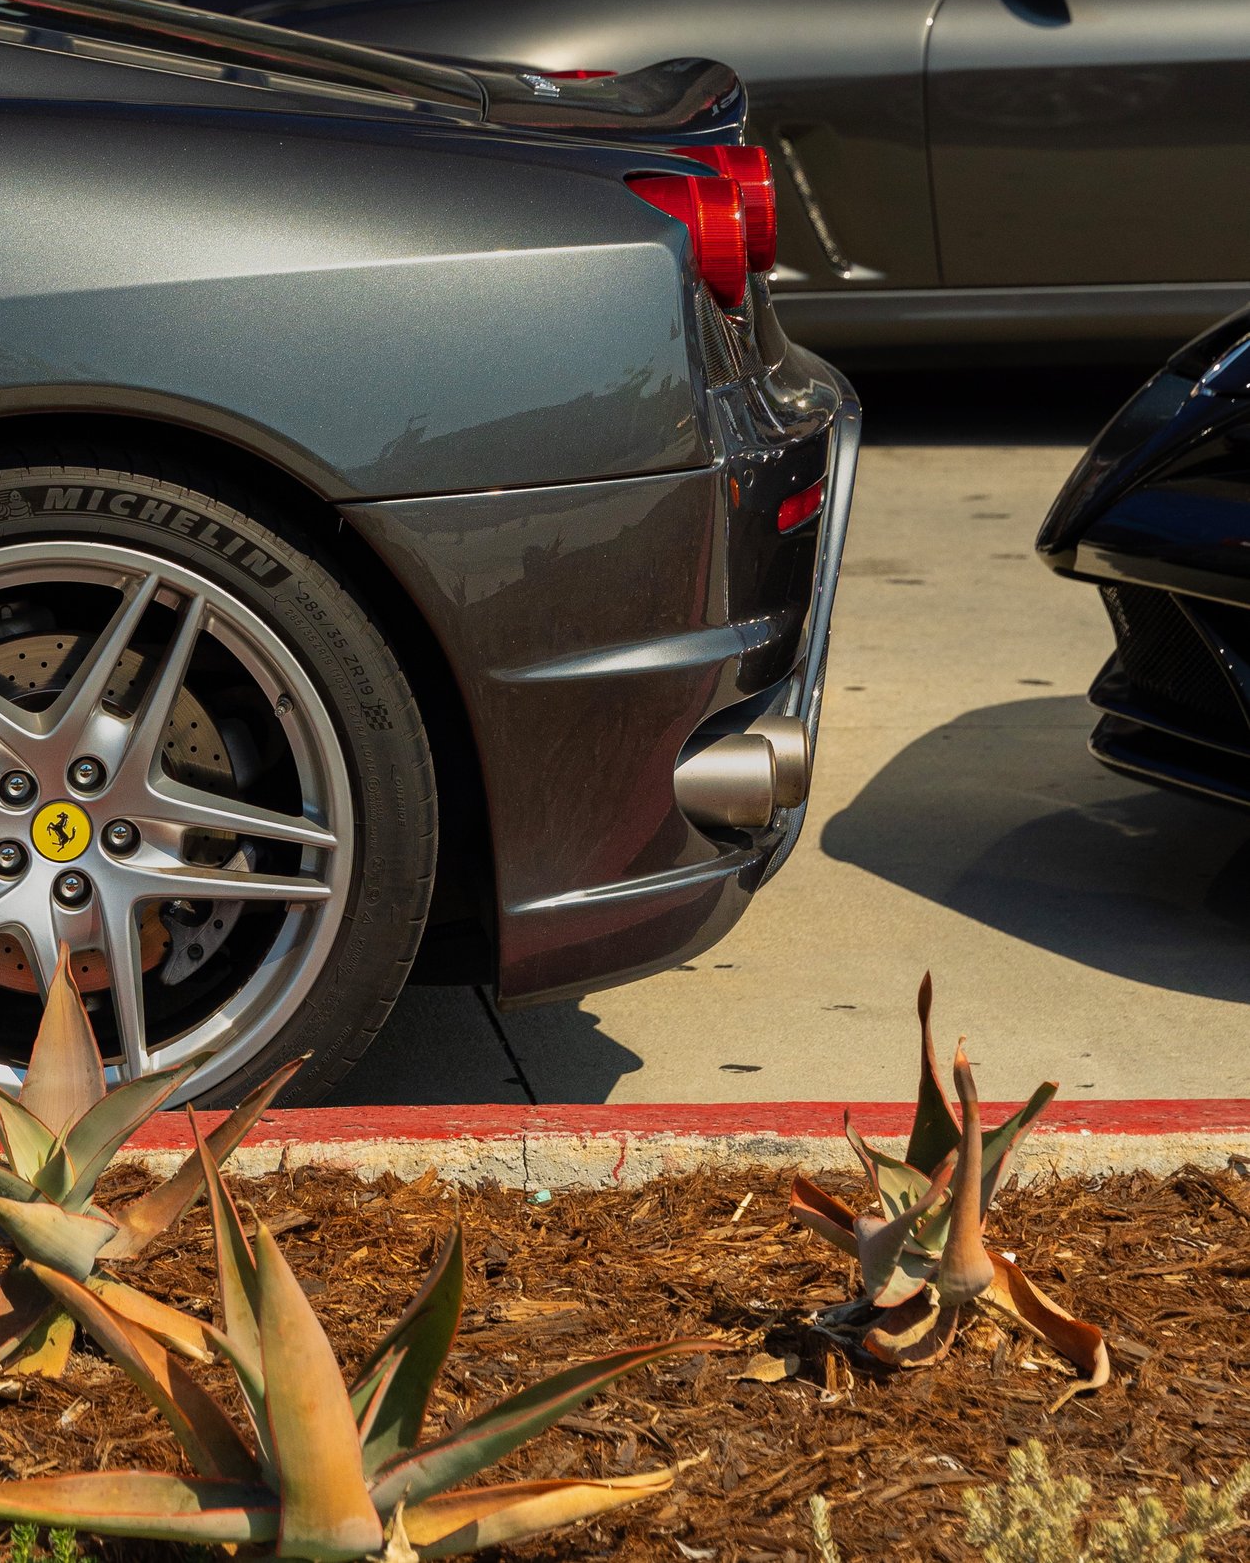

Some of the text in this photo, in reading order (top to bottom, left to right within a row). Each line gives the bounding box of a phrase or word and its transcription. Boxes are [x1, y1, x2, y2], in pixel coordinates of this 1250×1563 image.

[41, 486, 277, 582] MICHELIN
[294, 587, 375, 698] 285/35 ZR19
[392, 775, 407, 827] OUTSIDE
